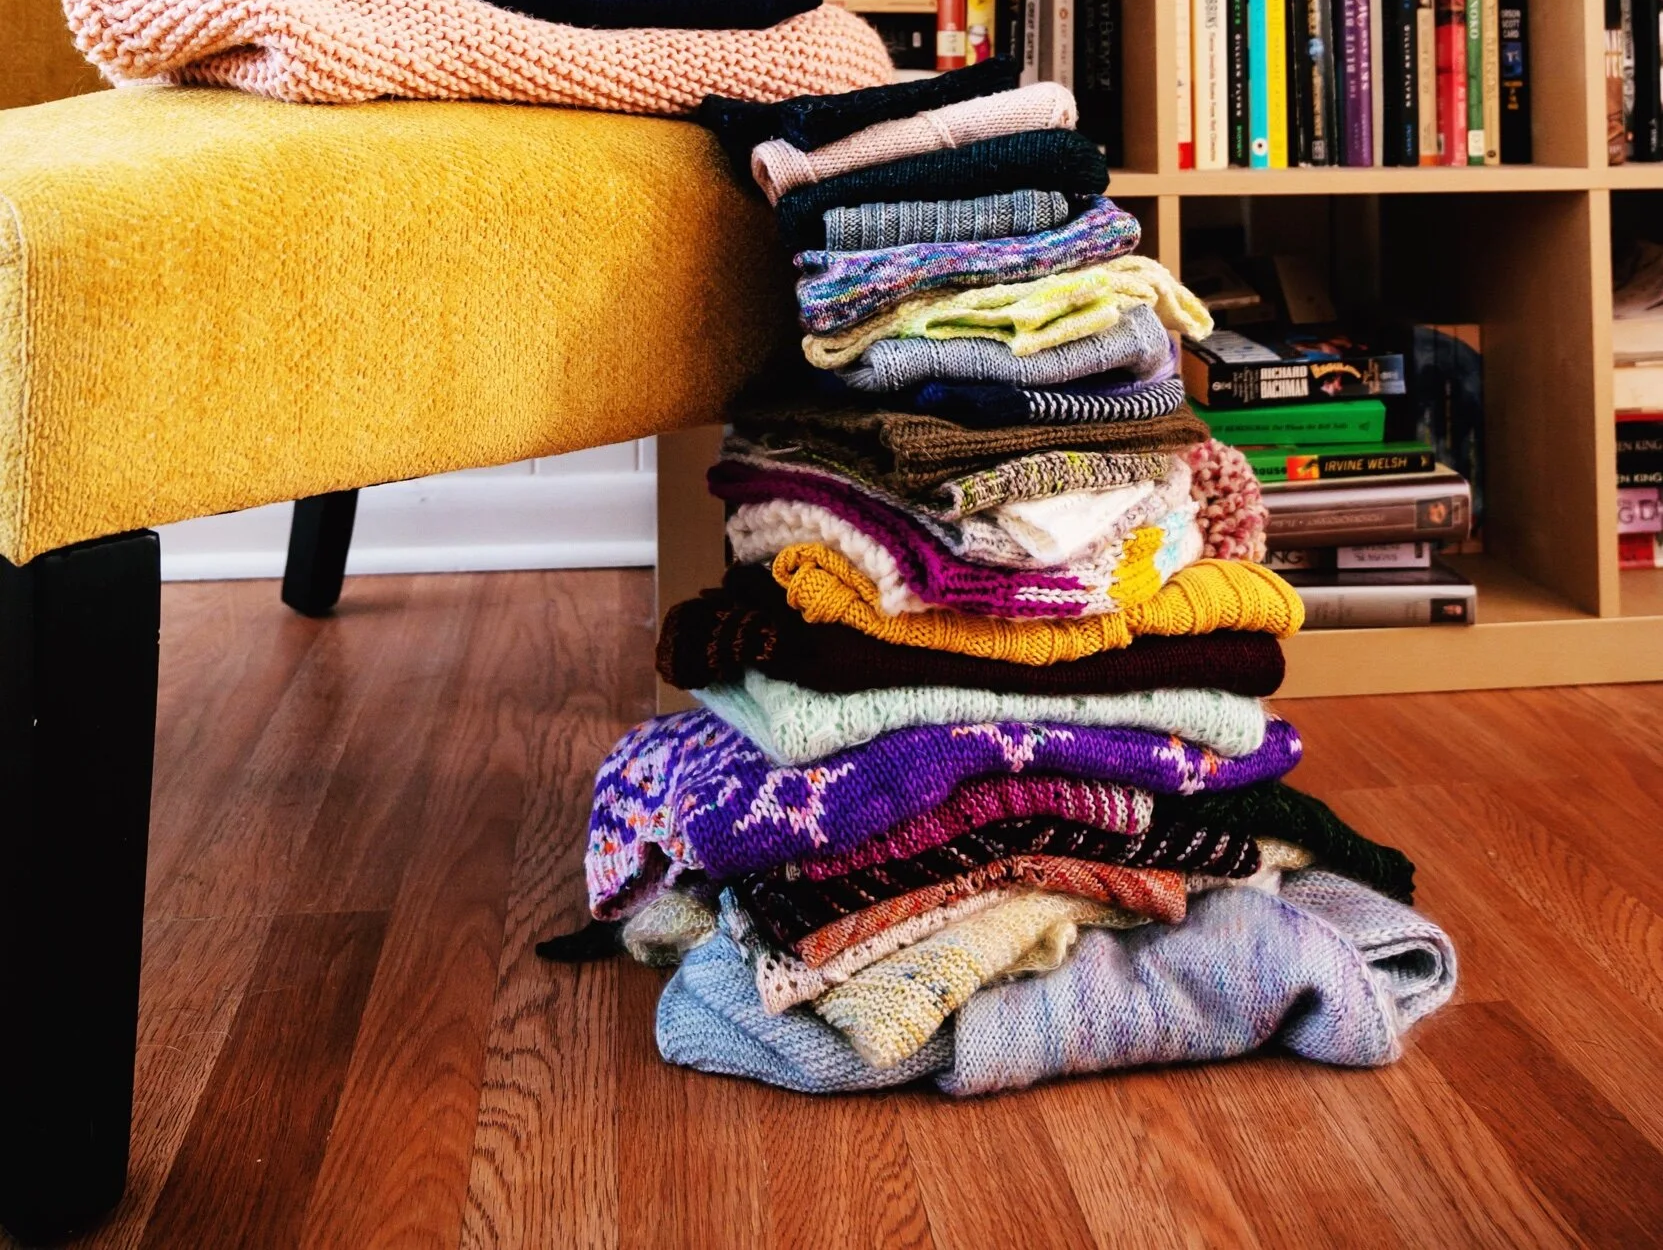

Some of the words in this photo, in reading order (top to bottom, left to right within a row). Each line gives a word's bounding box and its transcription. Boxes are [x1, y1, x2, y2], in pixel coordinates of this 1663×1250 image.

[1026, 0, 1036, 29] GREAT
[1025, 31, 1035, 67] GATSBY
[1234, 32, 1242, 77] GILLIAN
[1346, 33, 1356, 74] BLUE
[1404, 24, 1412, 69] GILLIAN
[1348, 79, 1357, 100] THE
[1360, 60, 1370, 92] SKY
[1405, 73, 1413, 108] FLYNN
[1235, 82, 1243, 118] FLYNN
[1260, 378, 1310, 400] BACHMAN
[1261, 365, 1309, 383] RICHARD
[1325, 458, 1364, 473] IRVINE
[1367, 455, 1408, 470] WELSH
[1633, 472, 1663, 484] KING
